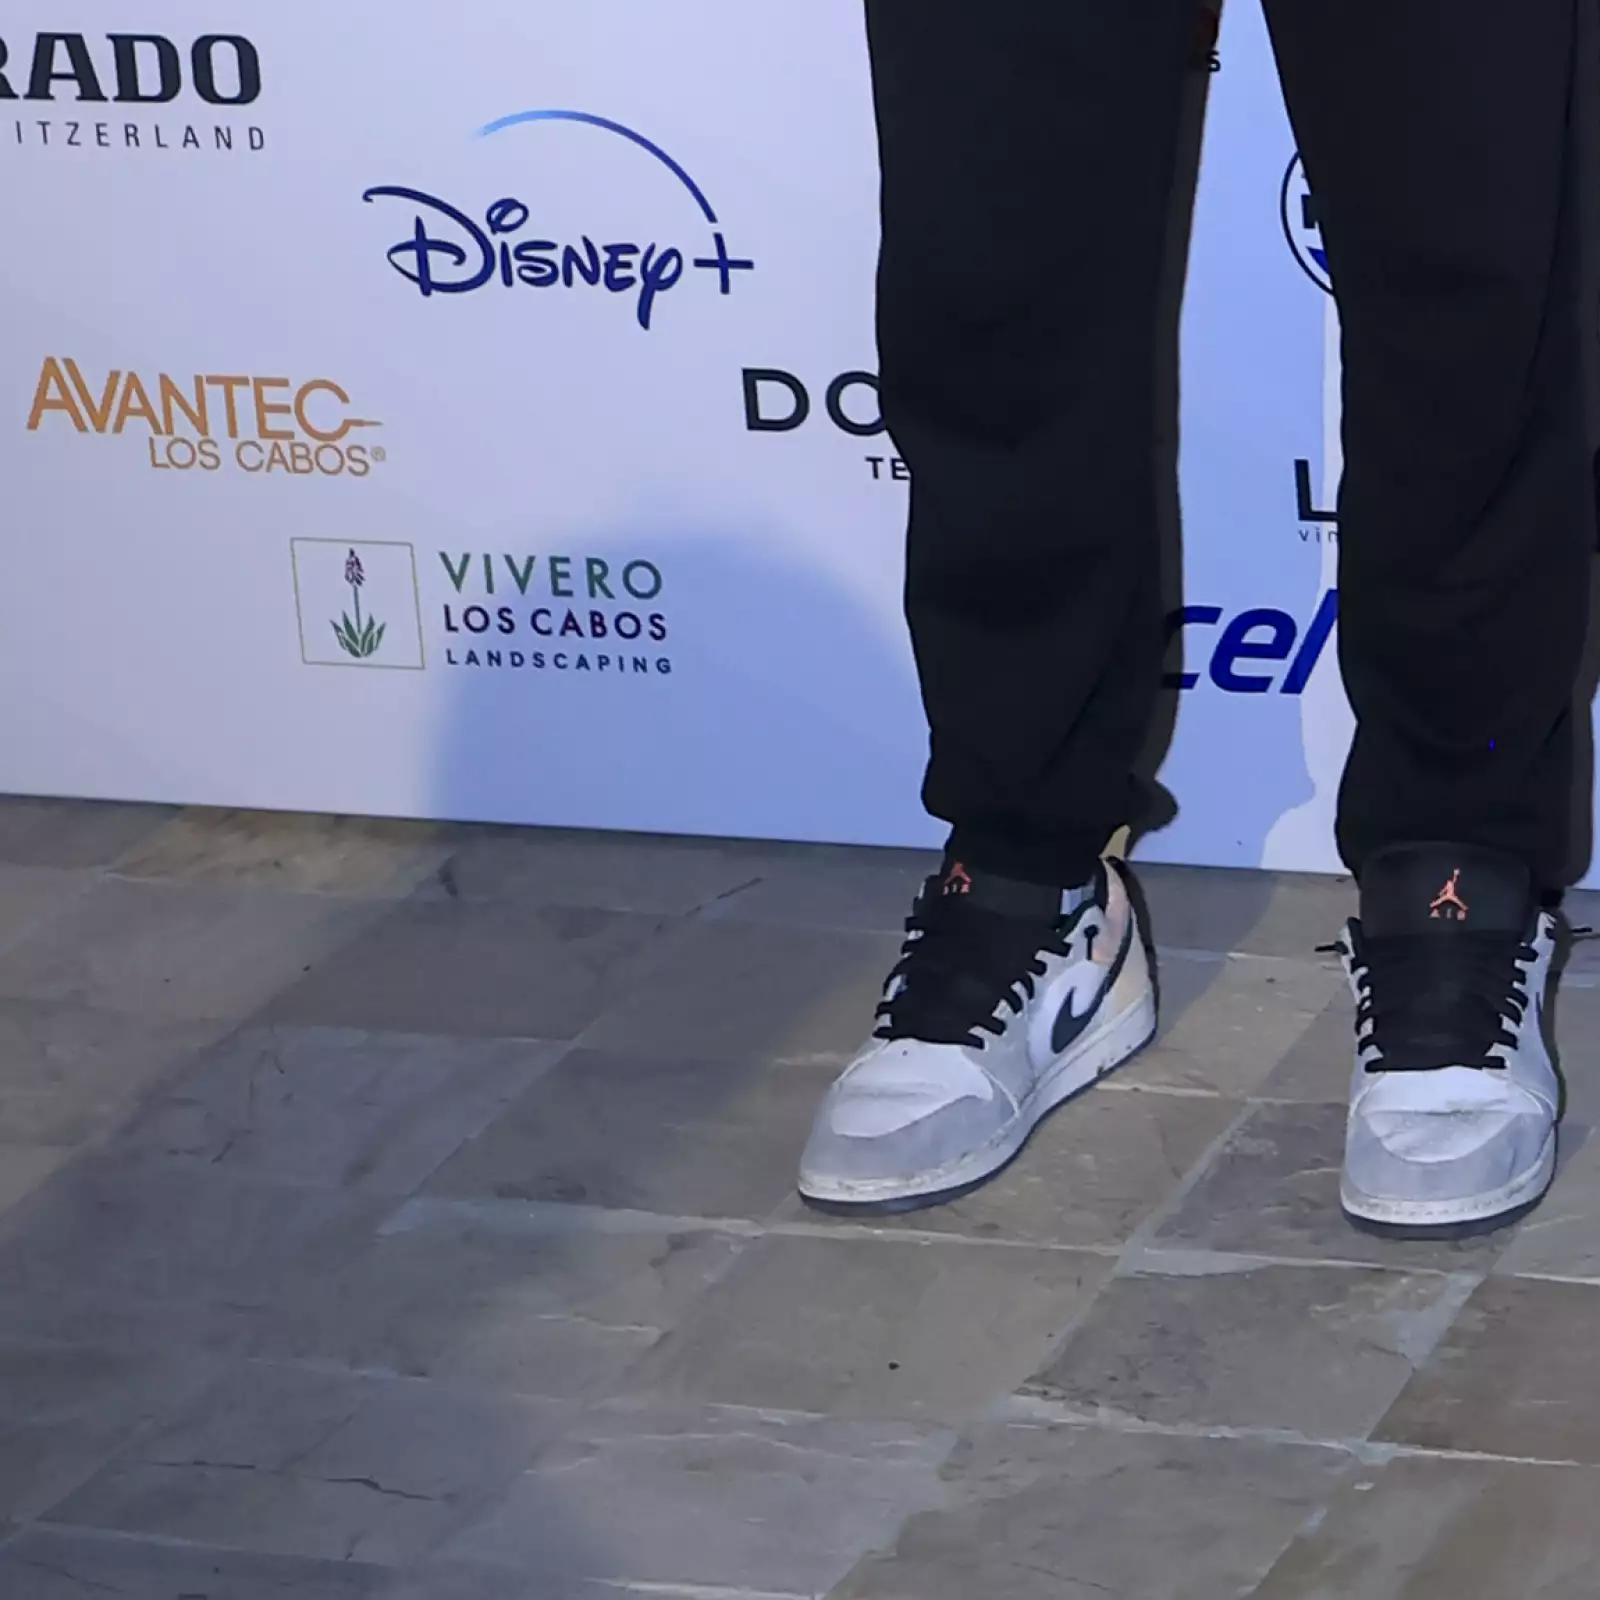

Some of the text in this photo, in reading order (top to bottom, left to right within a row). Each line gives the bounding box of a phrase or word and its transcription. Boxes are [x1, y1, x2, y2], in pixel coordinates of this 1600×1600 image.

[362, 186, 754, 330] Disney+
[27, 357, 383, 441] AVANTEC
[150, 435, 370, 478] LOS CABOS
[439, 552, 662, 602] VIVERO
[443, 604, 668, 641] LOS CABOS
[445, 649, 672, 676] LANDSCAPING
